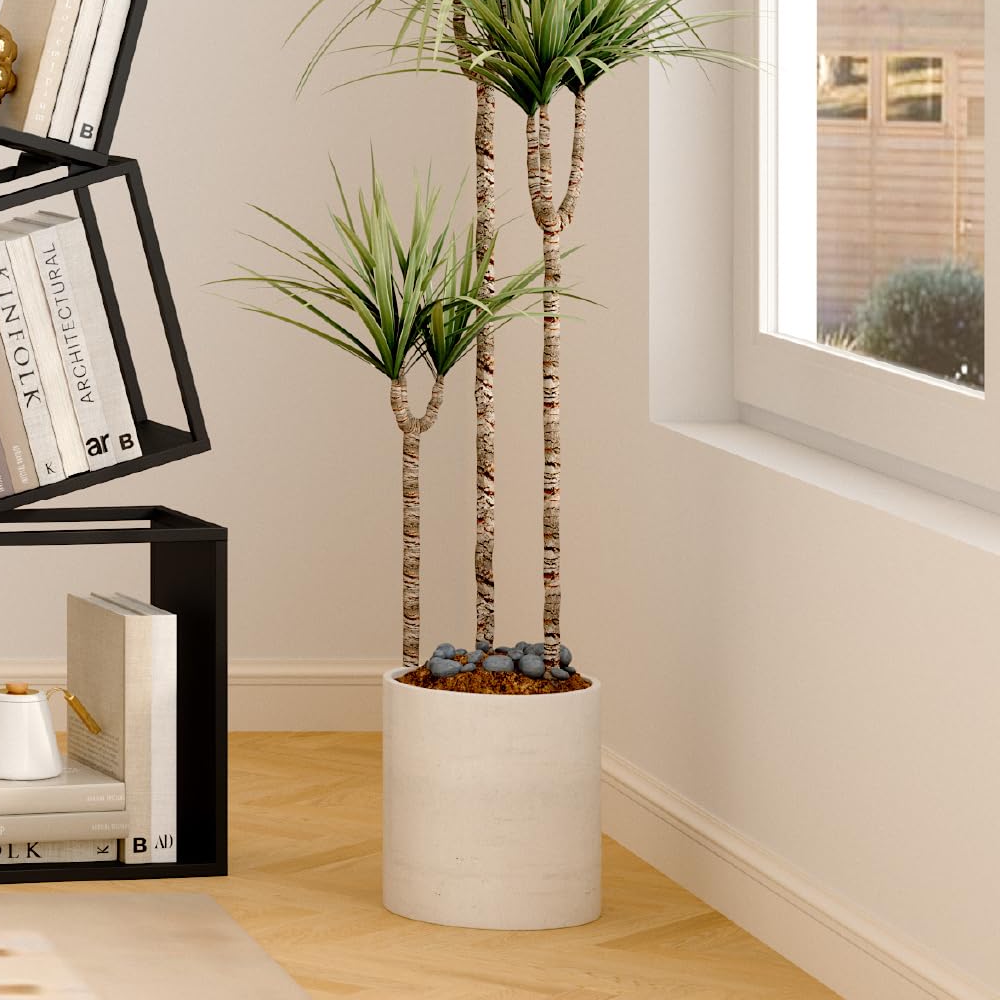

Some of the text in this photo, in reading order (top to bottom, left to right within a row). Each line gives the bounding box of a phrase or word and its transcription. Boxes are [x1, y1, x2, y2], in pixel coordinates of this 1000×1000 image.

[80, 123, 93, 139] B
[43, 242, 95, 403] ARCHITECTURAL
[86, 433, 109, 457] ar
[119, 433, 134, 450] B
[45, 463, 56, 475] K
[97, 845, 110, 854] K
[133, 837, 147, 853] B
[155, 834, 174, 849] AD
